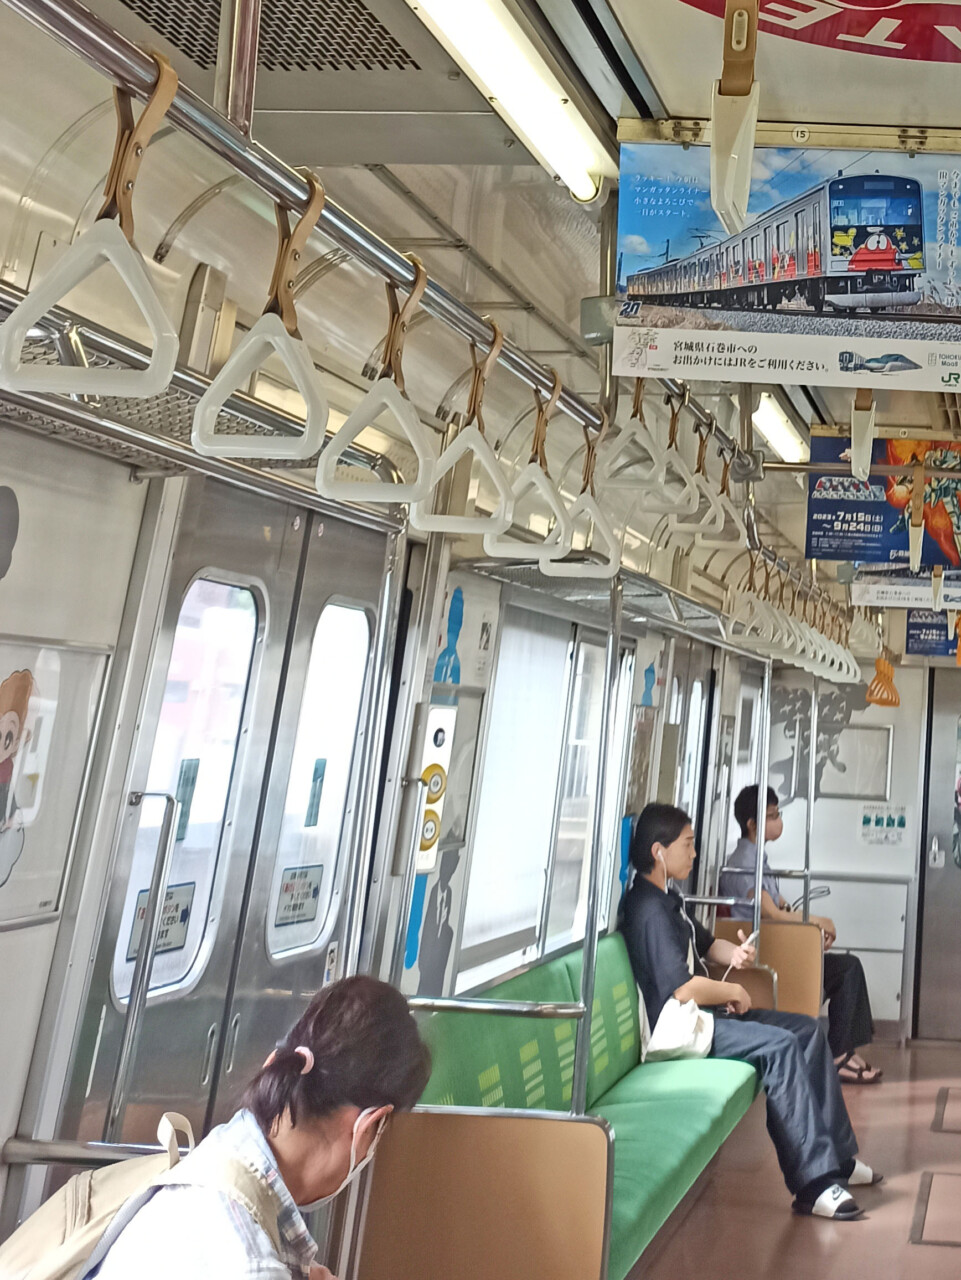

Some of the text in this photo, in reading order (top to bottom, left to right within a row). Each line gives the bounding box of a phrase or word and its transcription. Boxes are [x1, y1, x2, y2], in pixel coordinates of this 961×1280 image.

[796, 130, 806, 138] 15
[673, 340, 758, 354] 宮城県石巻市への
[672, 355, 829, 372] お出かけにはJRをご利用ください。
[941, 372, 960, 384] JR
